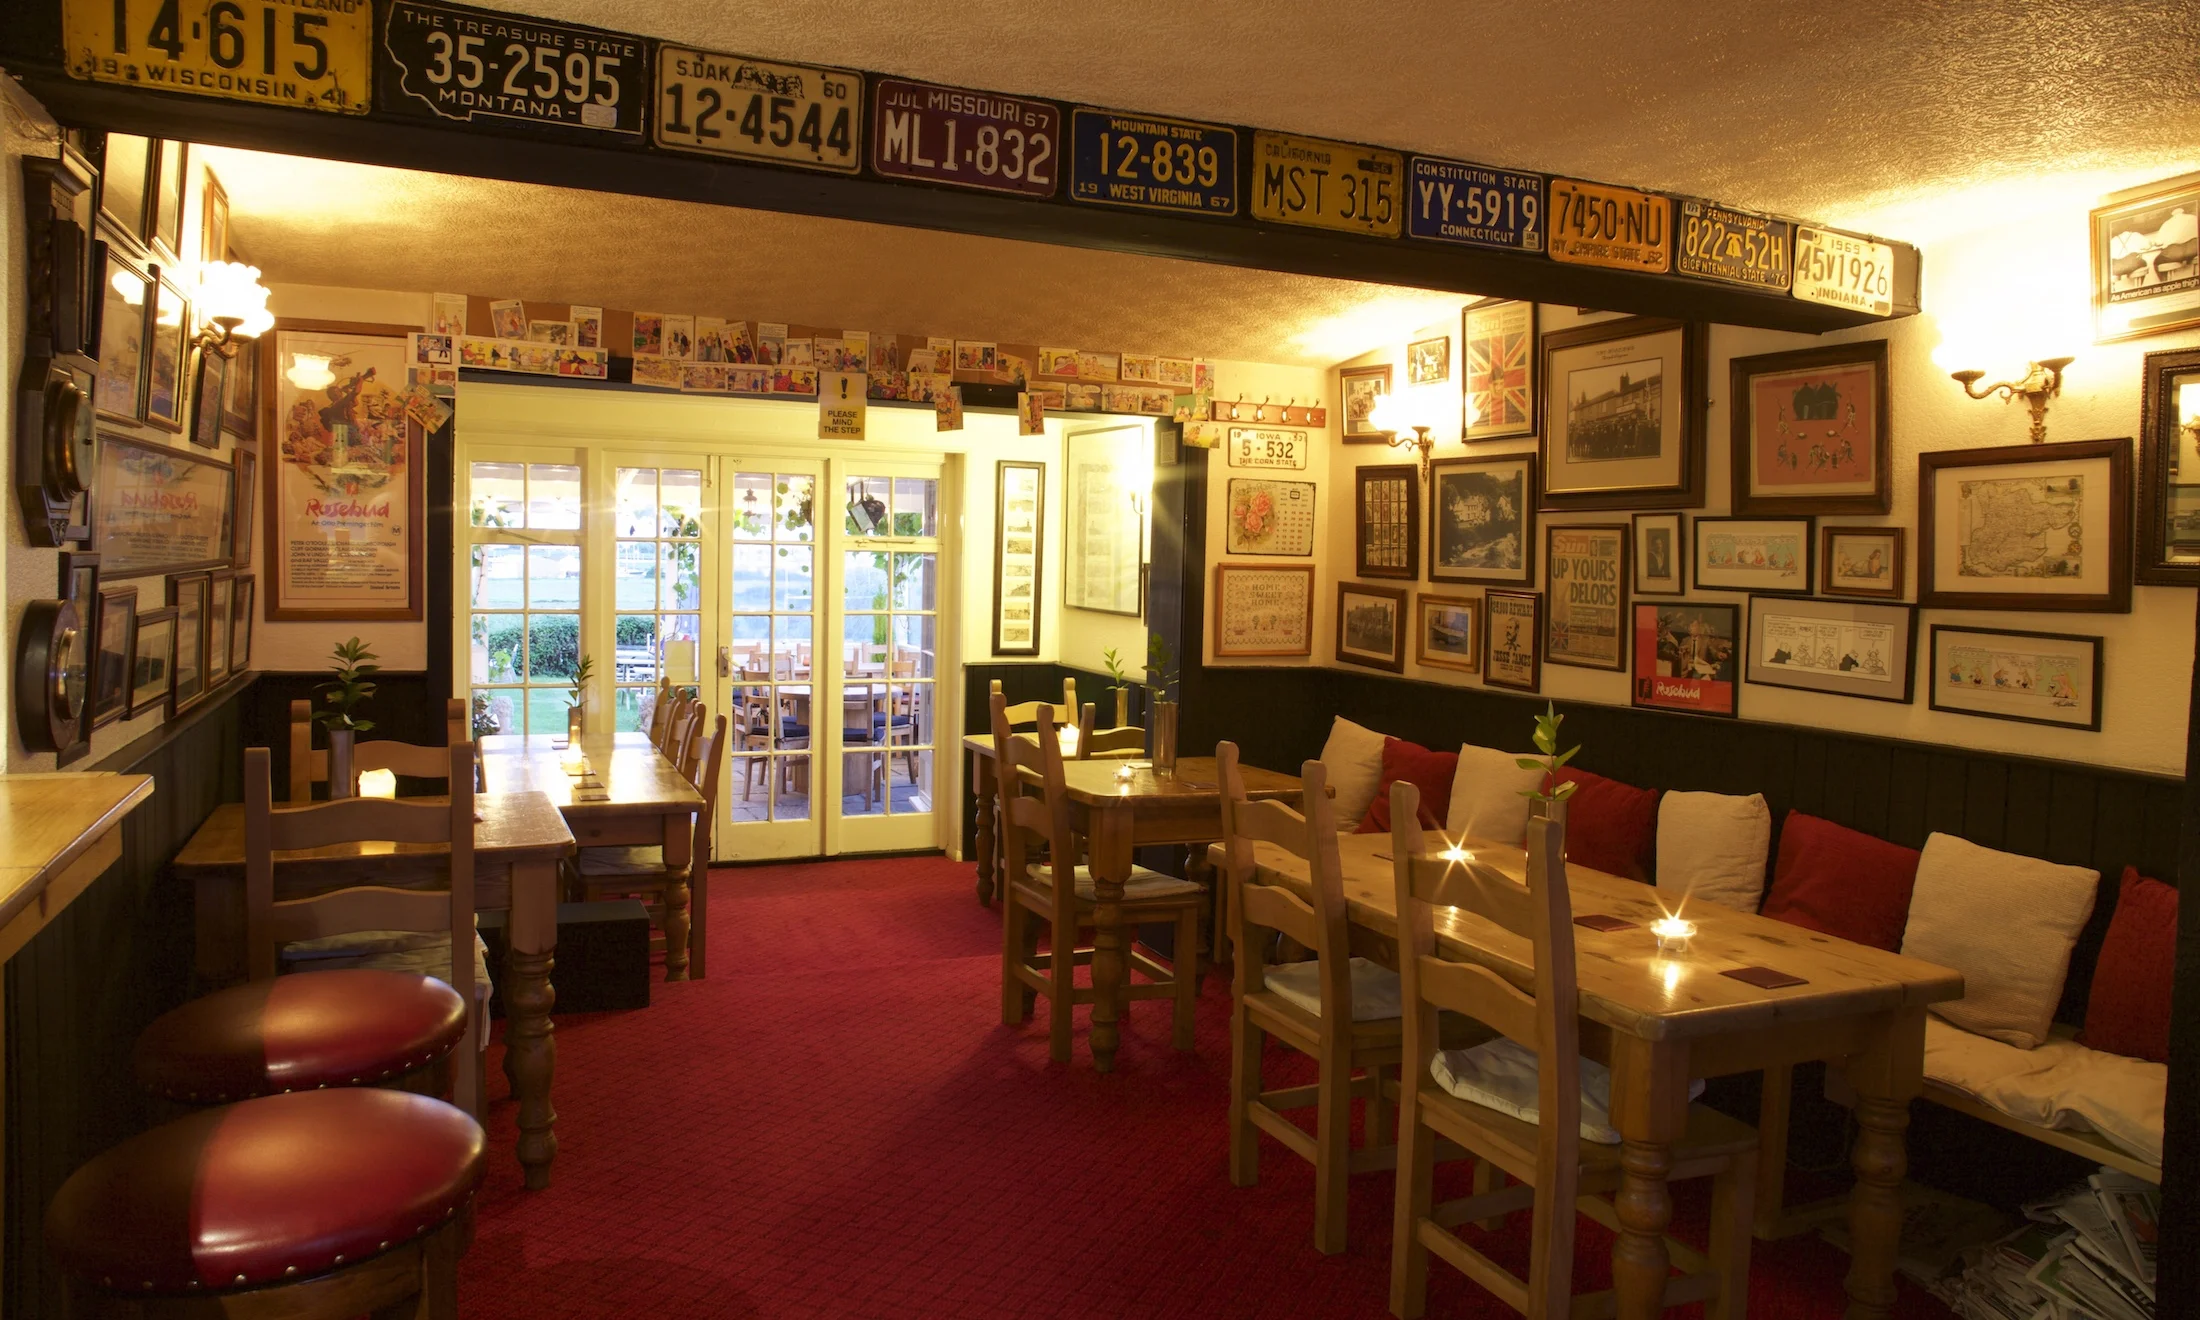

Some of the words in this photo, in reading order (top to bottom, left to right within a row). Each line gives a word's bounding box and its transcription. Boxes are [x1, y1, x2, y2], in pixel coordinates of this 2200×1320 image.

[403, 10, 444, 28] THE
[454, 19, 565, 47] TREASURE
[573, 38, 635, 57] STATE
[425, 31, 621, 107] 35-2595
[146, 64, 297, 99] WISCONSIN
[823, 81, 847, 100] 60
[886, 91, 923, 110] JUL
[928, 91, 1019, 123] MISSOURI
[1111, 119, 1168, 136] MOUNTAIN
[1171, 127, 1202, 141] STATE
[1100, 132, 1218, 187] 12-839
[1265, 143, 1331, 165] CALIFORNIA
[1416, 163, 1496, 185] CONSTITUTION
[1503, 175, 1538, 192] STATE
[1078, 182, 1098, 194] 19
[1109, 184, 1146, 201] WEST
[1149, 187, 1203, 207] VIRGINIA
[1210, 196, 1230, 208] 67
[1263, 162, 1330, 215] MST
[1340, 173, 1393, 224] 315
[1707, 208, 1766, 230] PENNSYLVANIA
[1441, 223, 1515, 243] CONNECTICUT
[1686, 216, 1725, 262] 822
[1744, 229, 1783, 271] 52H
[1742, 267, 1766, 282] STATE
[1818, 287, 1867, 306] INDIANA
[2111, 294, 2120, 302] As
[2120, 288, 2153, 300] American
[2162, 282, 2182, 293] apple
[827, 410, 857, 418] PLEASE
[841, 426, 861, 434] STEP
[1256, 432, 1281, 440] IOWA
[1276, 459, 1297, 467] STATE
[305, 498, 389, 518] Rosebud
[1553, 558, 1569, 579] UP
[1572, 559, 1616, 582] YOURS
[1570, 582, 1617, 607] DELORS
[1656, 681, 1700, 700] Rosebud
